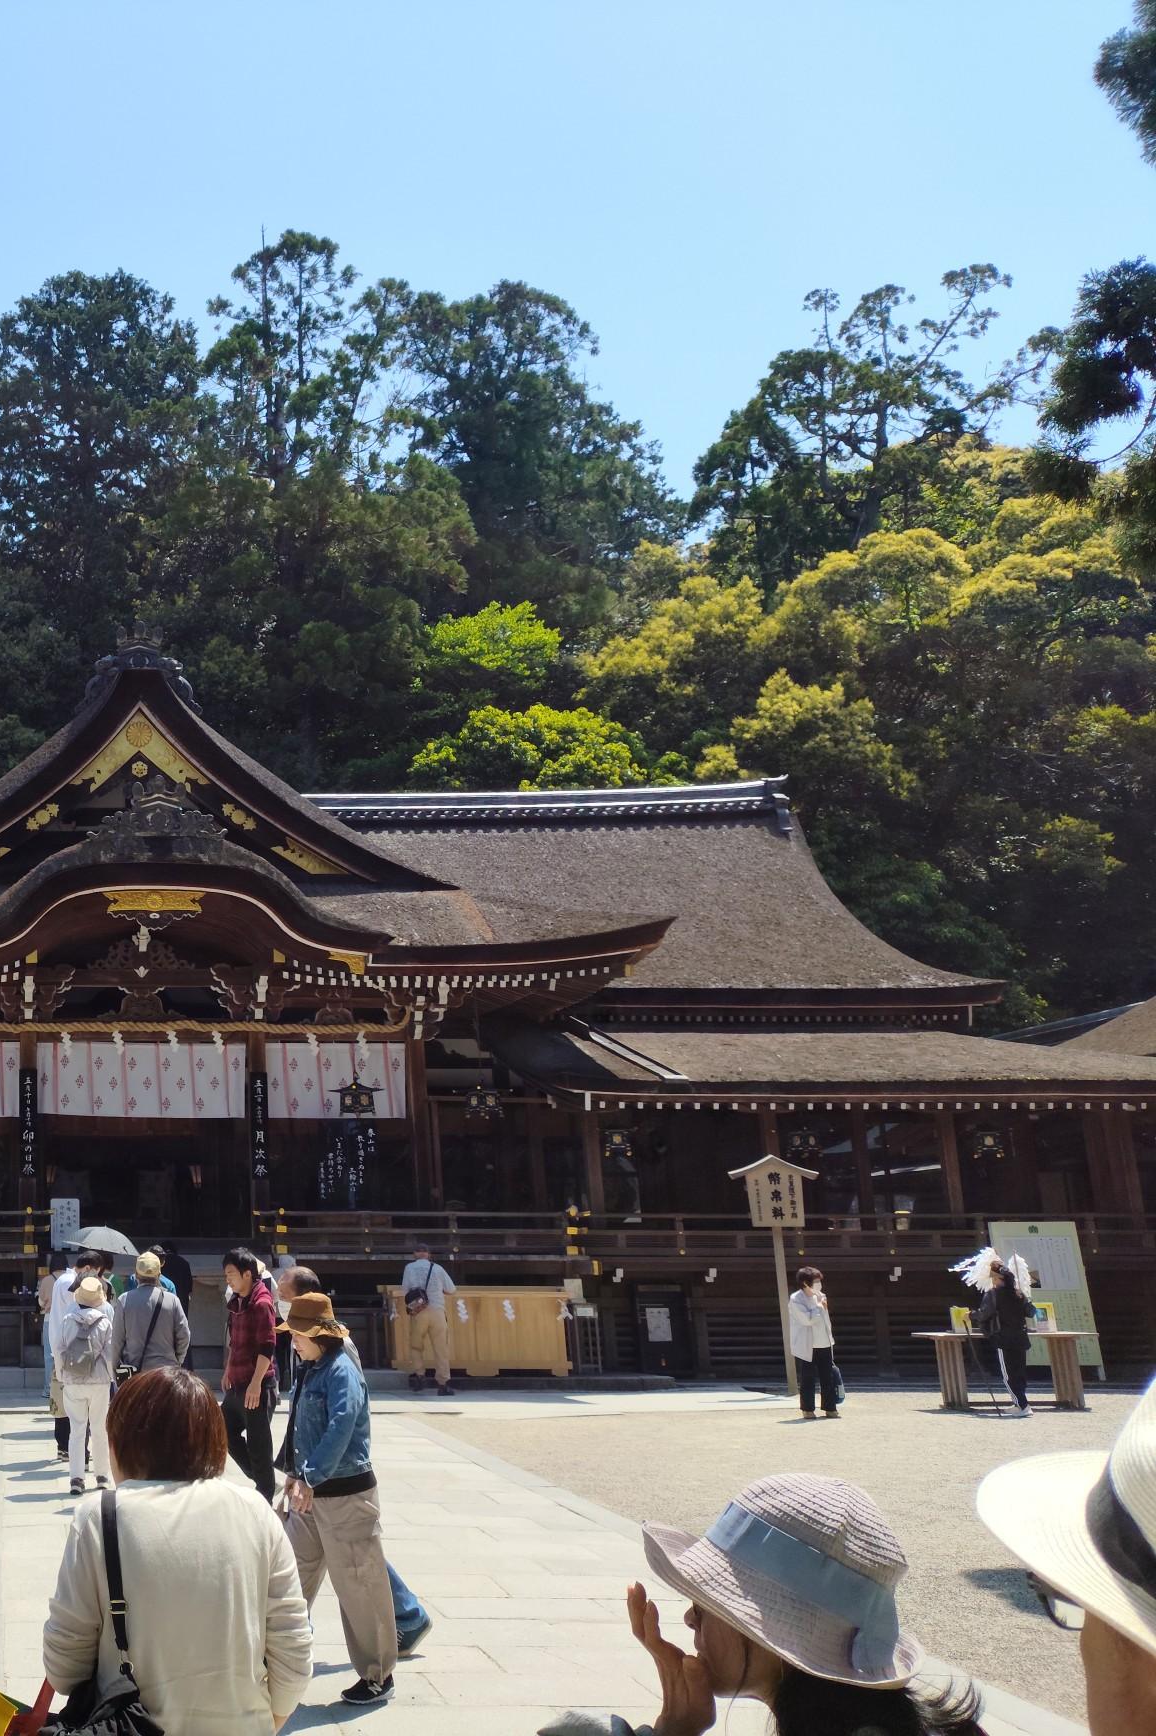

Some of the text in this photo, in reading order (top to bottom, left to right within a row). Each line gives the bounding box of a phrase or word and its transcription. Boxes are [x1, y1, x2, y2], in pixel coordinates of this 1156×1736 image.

[22, 1129, 35, 1175] 卯の日祭
[254, 1130, 268, 1177] 月次祭
